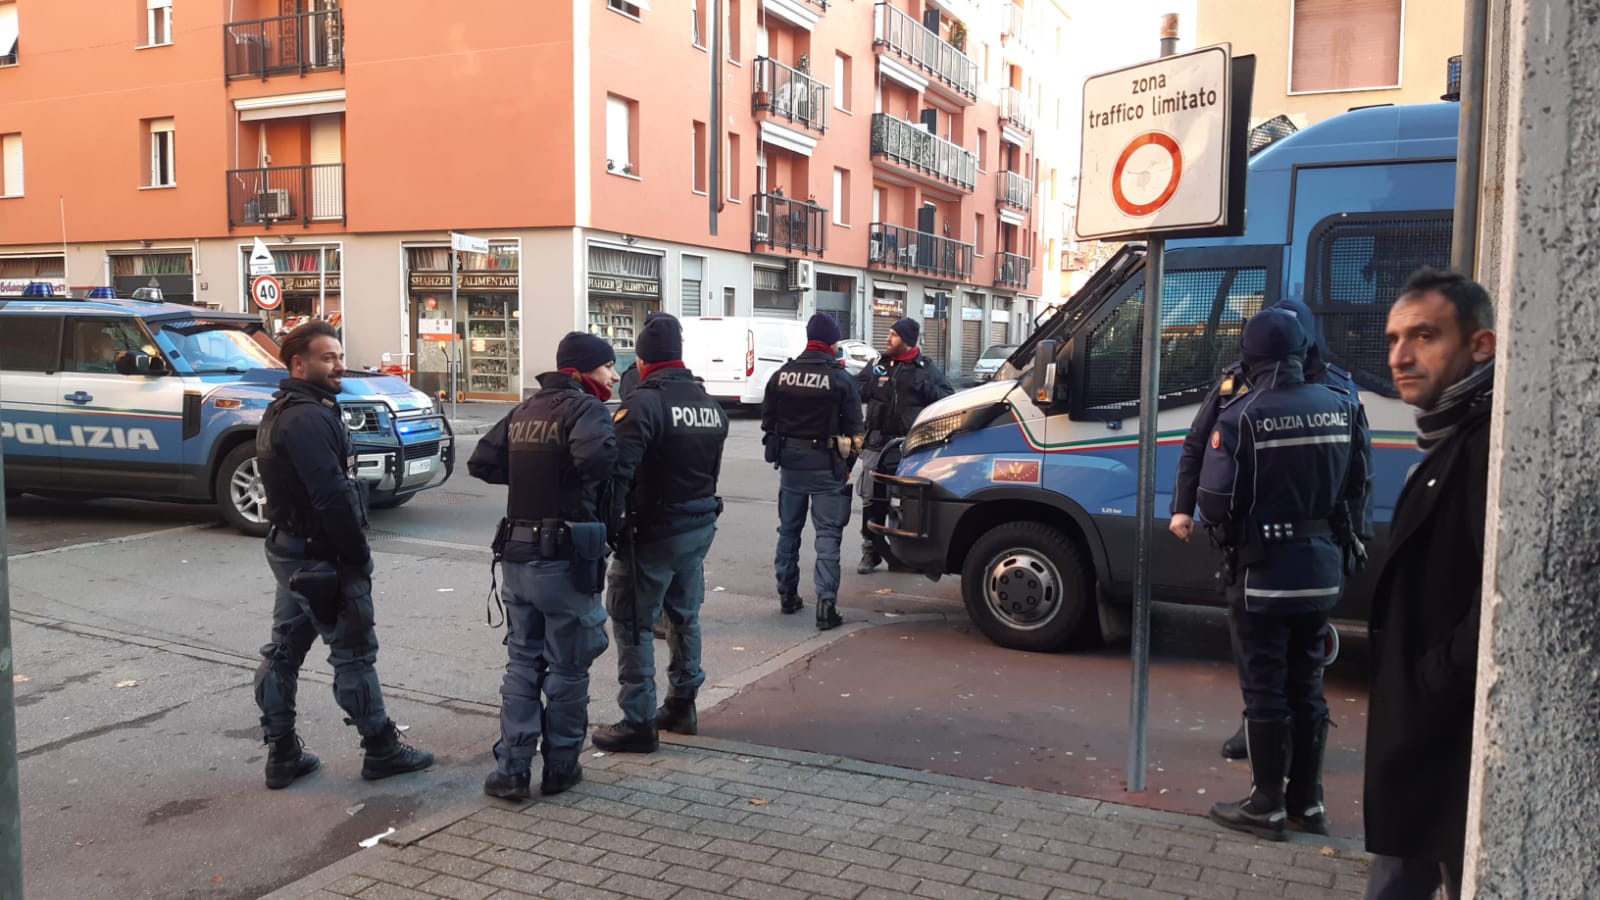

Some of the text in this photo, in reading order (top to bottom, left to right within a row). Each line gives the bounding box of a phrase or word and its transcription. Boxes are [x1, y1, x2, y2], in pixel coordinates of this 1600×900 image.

[1132, 73, 1166, 94] zona
[1089, 87, 1216, 128] traffico limitato
[411, 276, 518, 286] SHAHZER ALIMENTARI
[623, 281, 659, 293] ALIMENTARI
[260, 284, 275, 300] 40
[778, 371, 831, 390] POLIZIA
[672, 406, 722, 428] POLIZIA
[1256, 412, 1348, 433] POLIZIA LOCALE
[508, 420, 561, 444] POLIZIA
